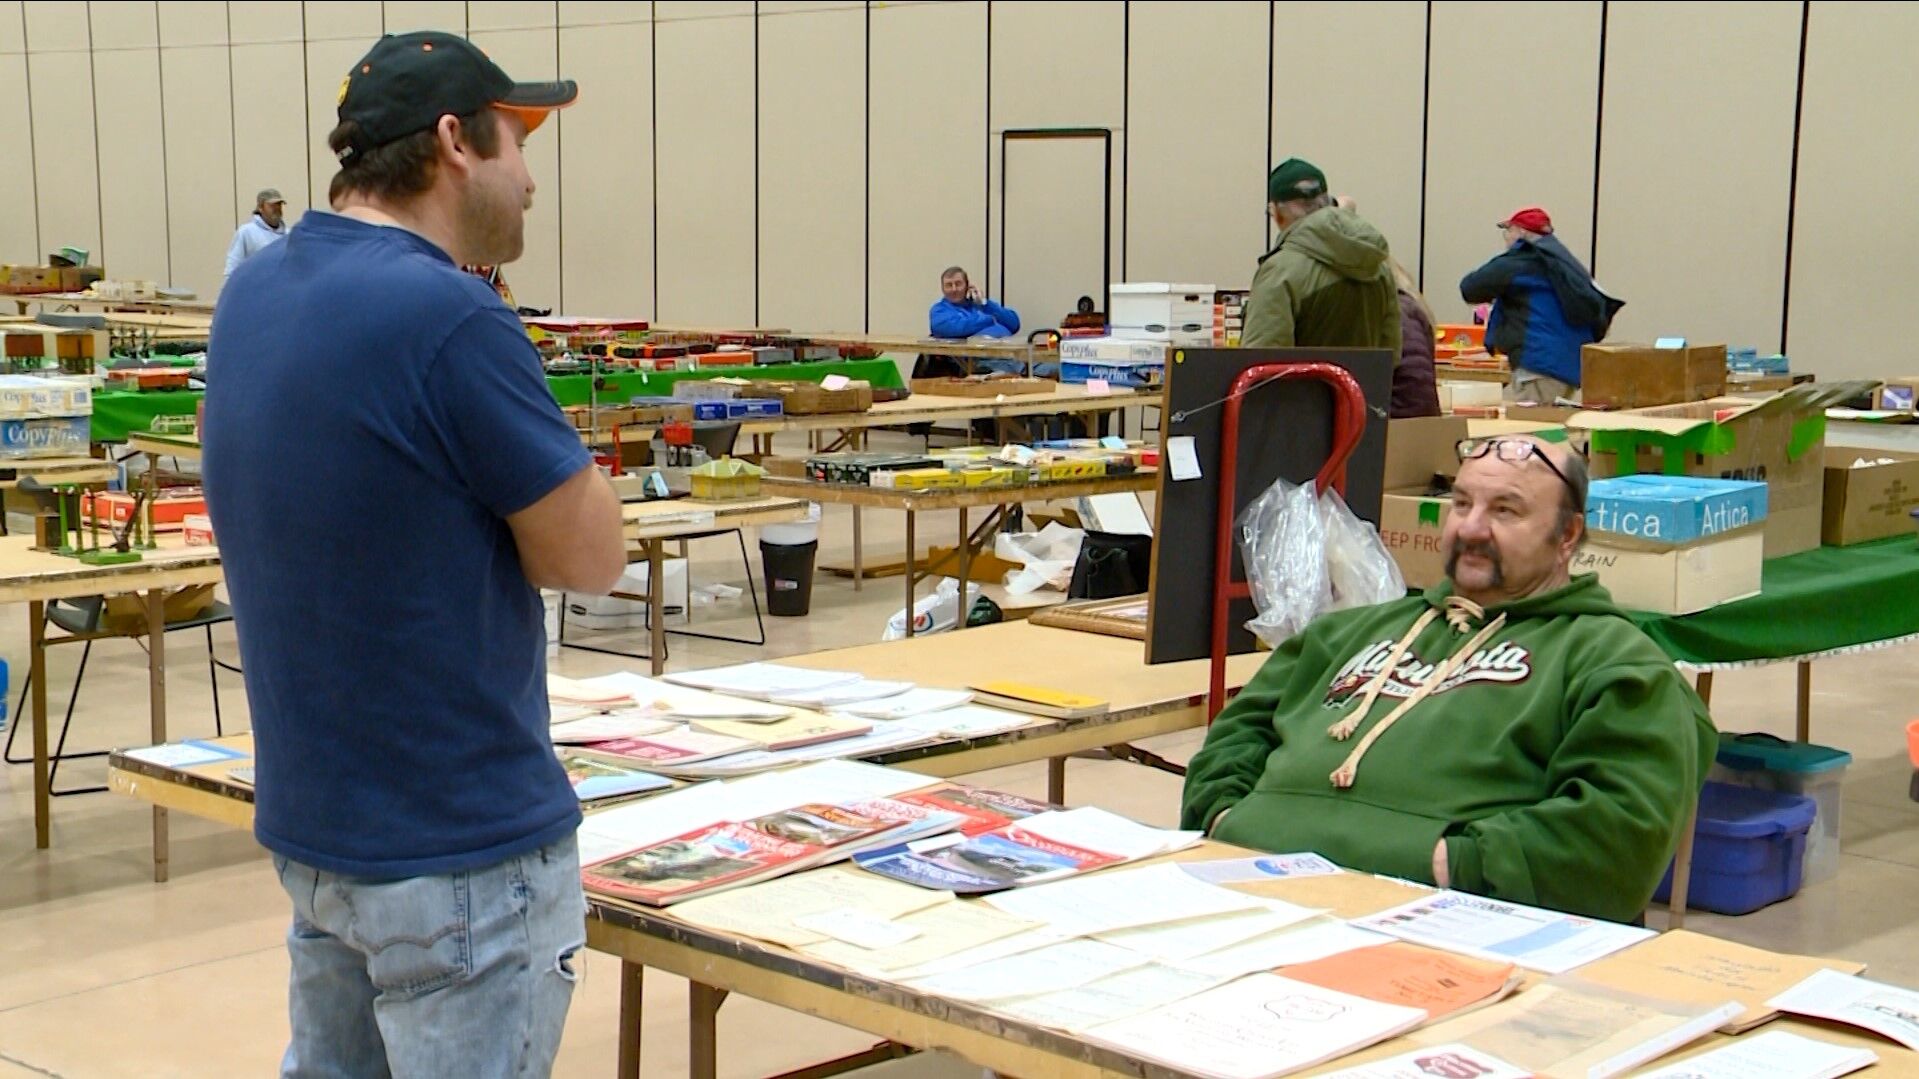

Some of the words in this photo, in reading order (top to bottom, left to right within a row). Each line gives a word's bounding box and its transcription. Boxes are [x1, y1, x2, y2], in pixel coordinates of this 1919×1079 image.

[1596, 502, 1661, 537] tica
[1701, 500, 1749, 536] Artica
[1381, 530, 1409, 548] EEP
